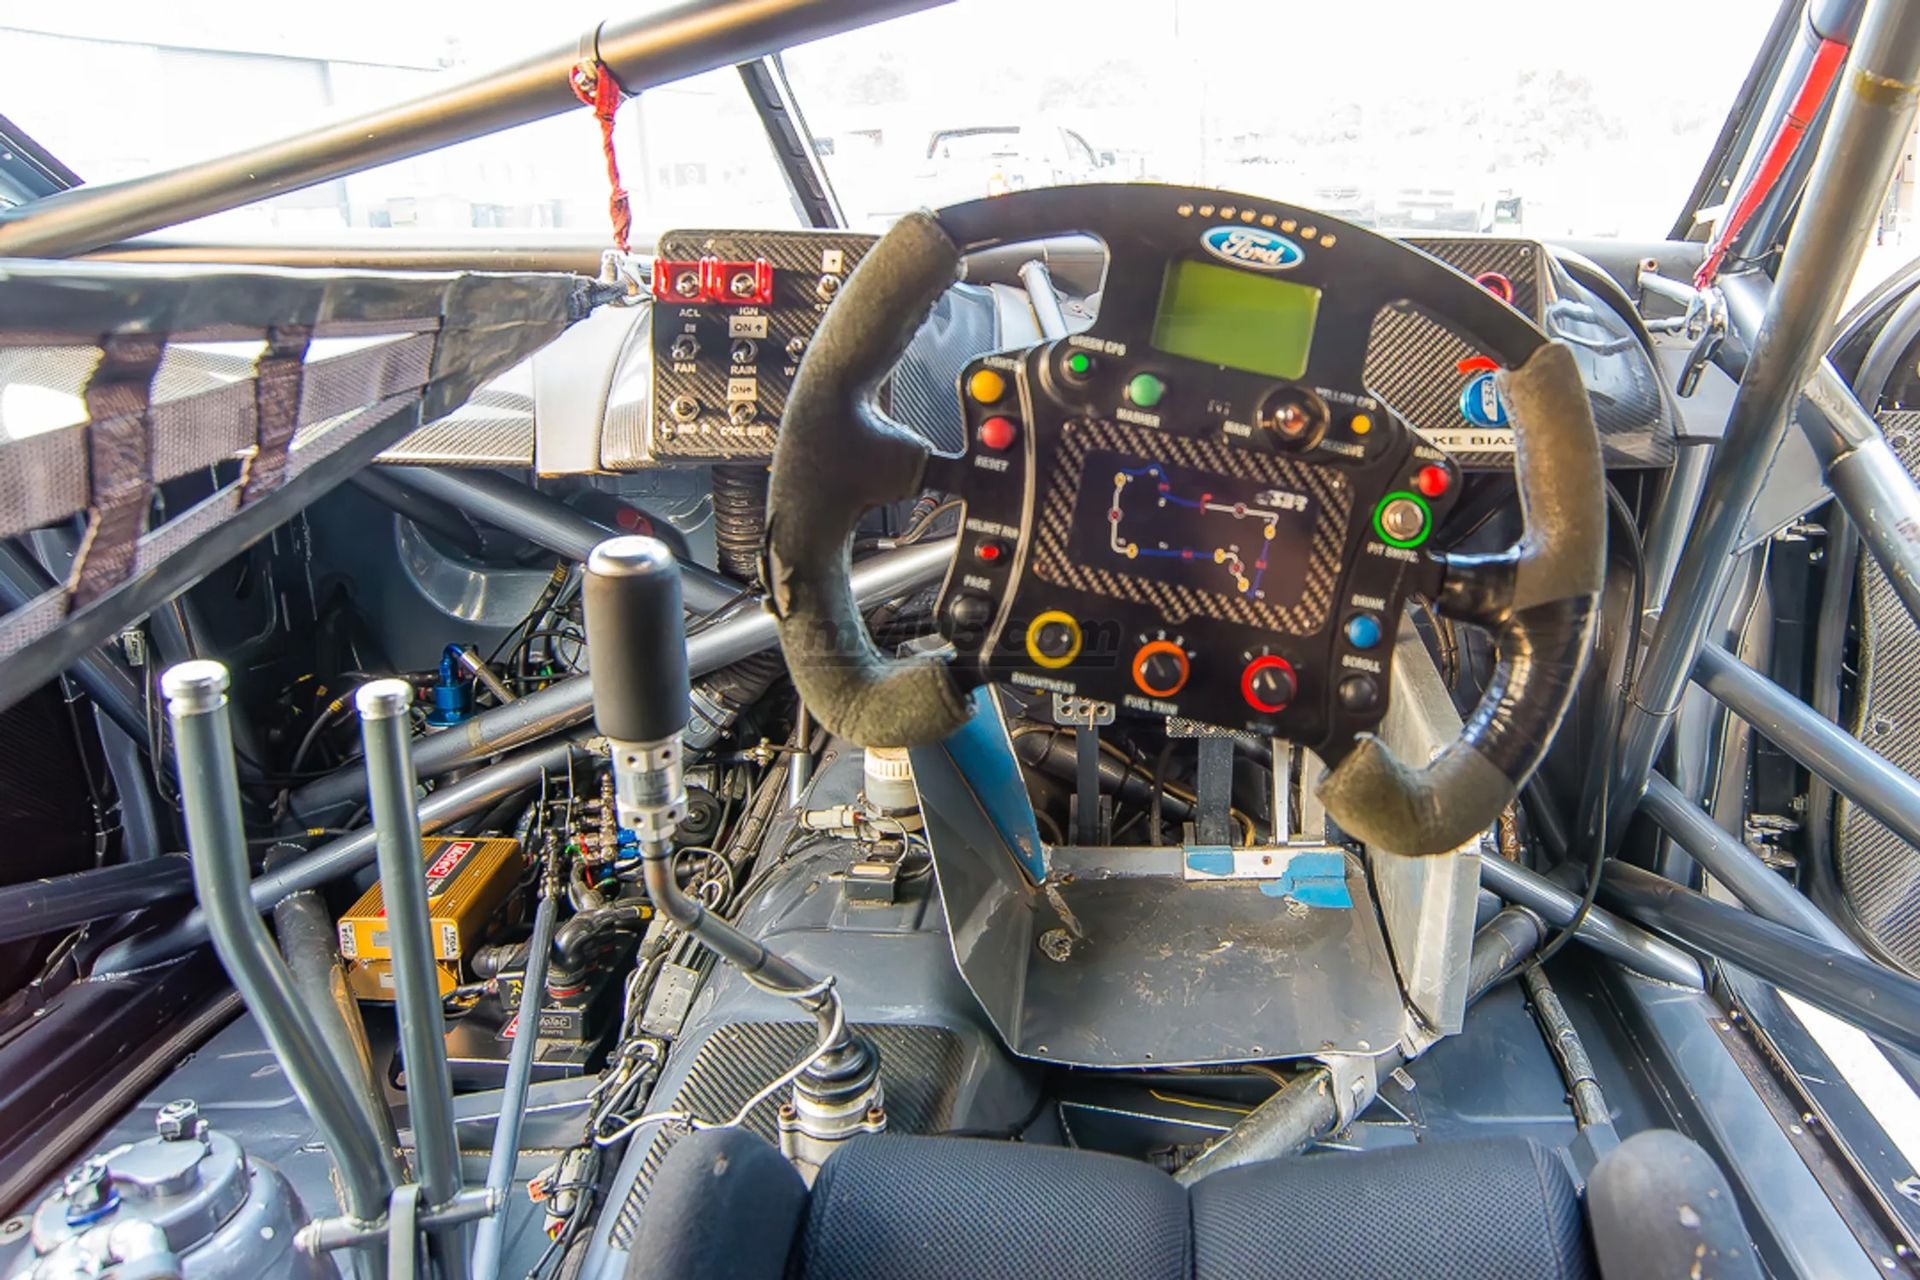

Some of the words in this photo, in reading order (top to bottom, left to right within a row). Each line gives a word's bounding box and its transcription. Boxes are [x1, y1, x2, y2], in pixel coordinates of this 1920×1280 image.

[1220, 230, 1286, 265] Ford
[738, 306, 759, 316] IGN
[734, 322, 752, 332] ON
[673, 363, 696, 373] FAN
[730, 365, 757, 376] RAIN
[730, 385, 748, 395] ON
[1010, 671, 1077, 695] BRIGHTNESS
[1123, 695, 1152, 713] FUEL
